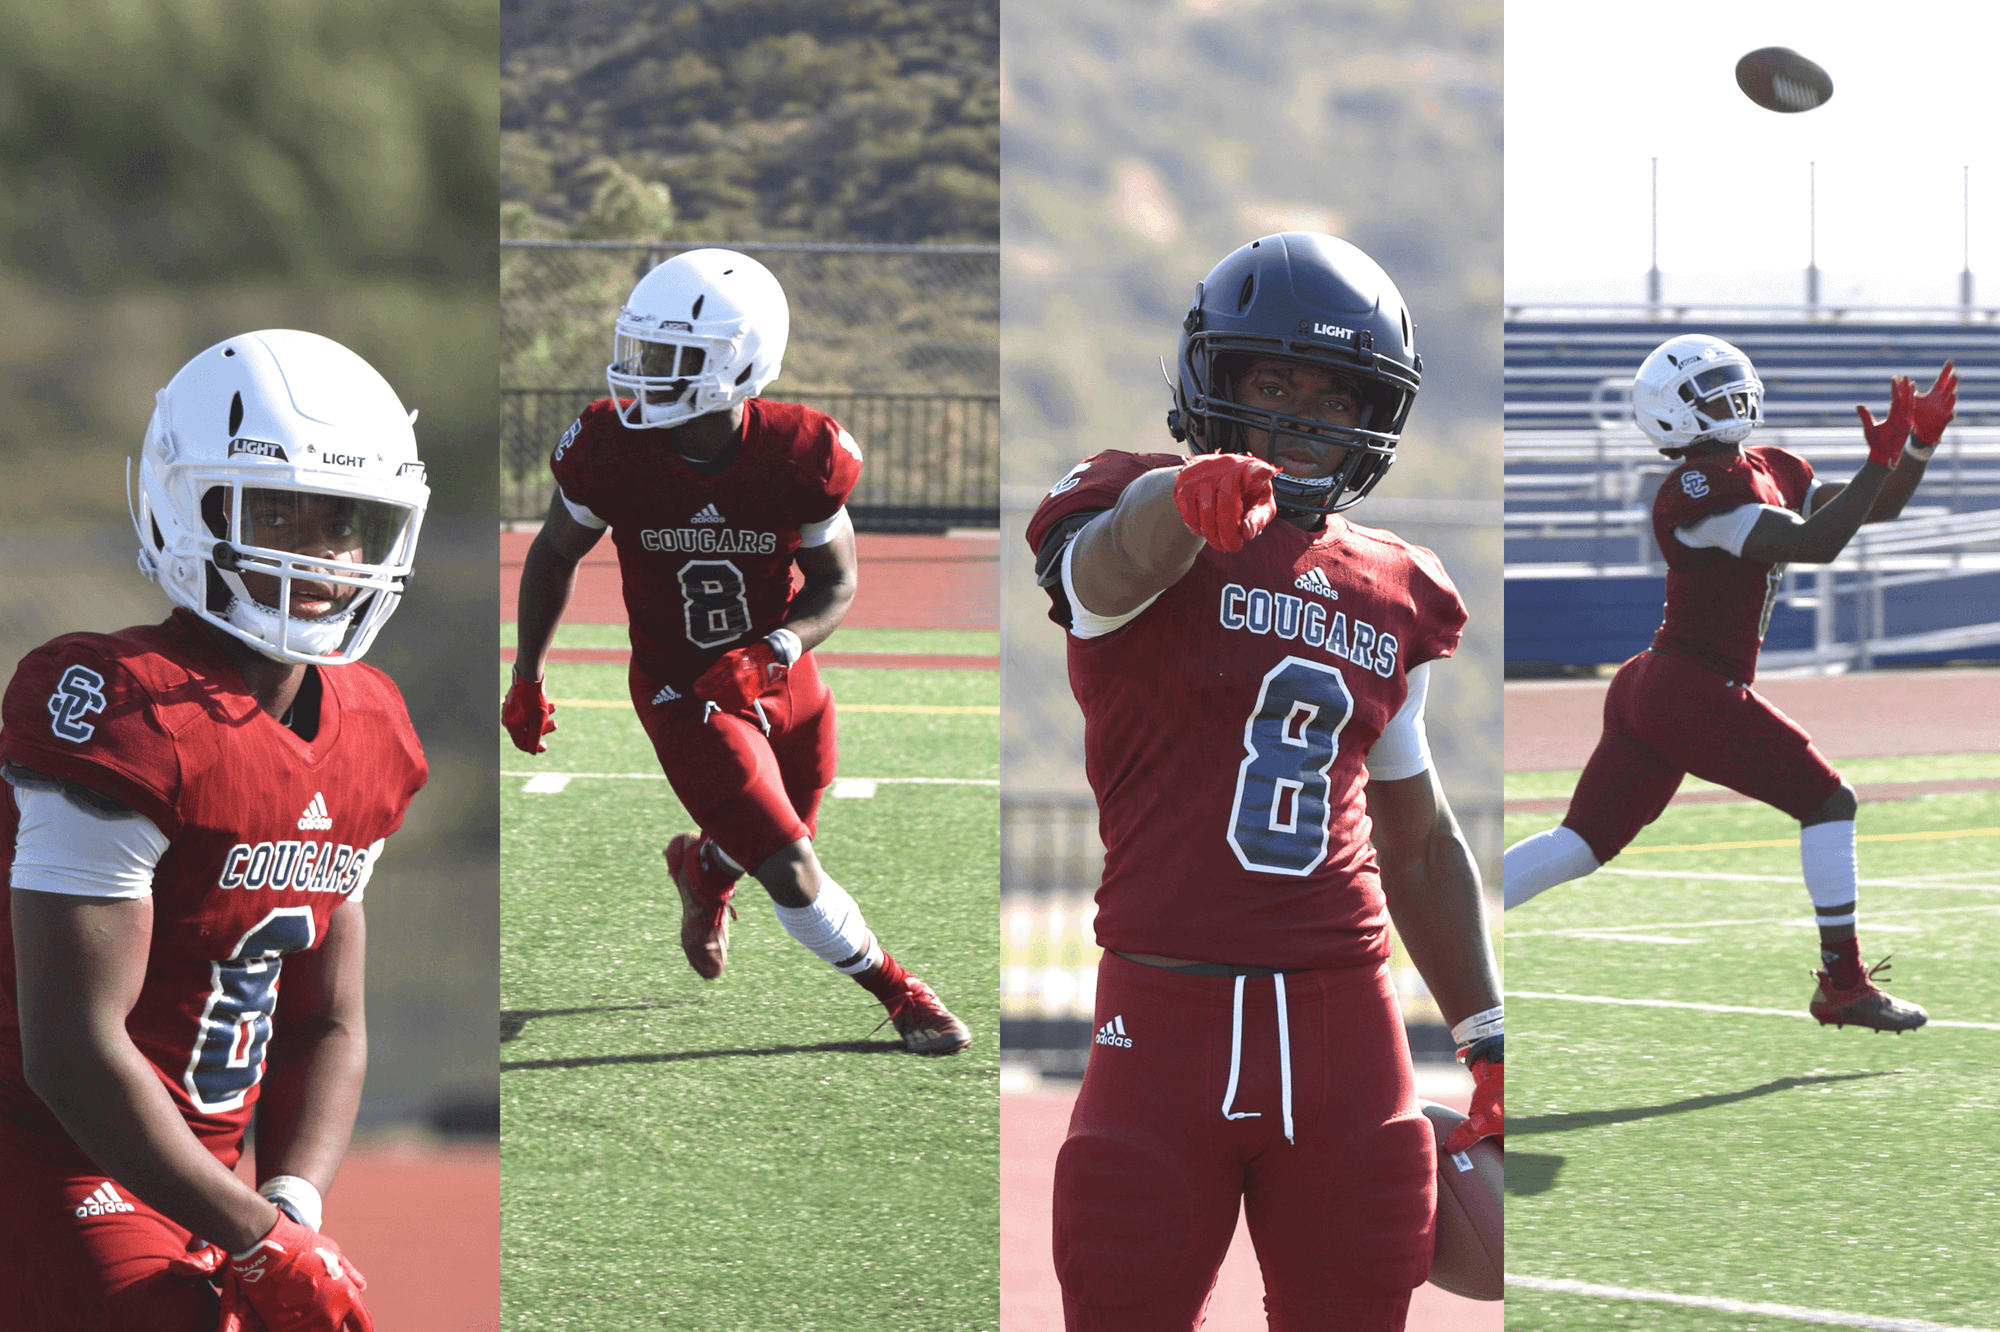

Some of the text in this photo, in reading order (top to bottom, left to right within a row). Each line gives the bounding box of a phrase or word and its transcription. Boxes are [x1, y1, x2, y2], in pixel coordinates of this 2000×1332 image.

[1313, 322, 1354, 340] LIGHT
[233, 439, 281, 458] LIGHT
[322, 452, 367, 468] LIGHT
[1680, 470, 1711, 499] SC
[690, 515, 726, 524] adidas
[640, 528, 777, 554] COUGARS
[1293, 577, 1340, 601] adidas
[676, 559, 753, 649] 8
[1219, 582, 1399, 679] COUGARS
[46, 663, 108, 744] SC
[1225, 654, 1355, 878] 8
[296, 815, 334, 831] adidas
[218, 839, 369, 895] COUGARS
[1095, 1032, 1133, 1048] adidas
[75, 1200, 136, 1218] adidas
